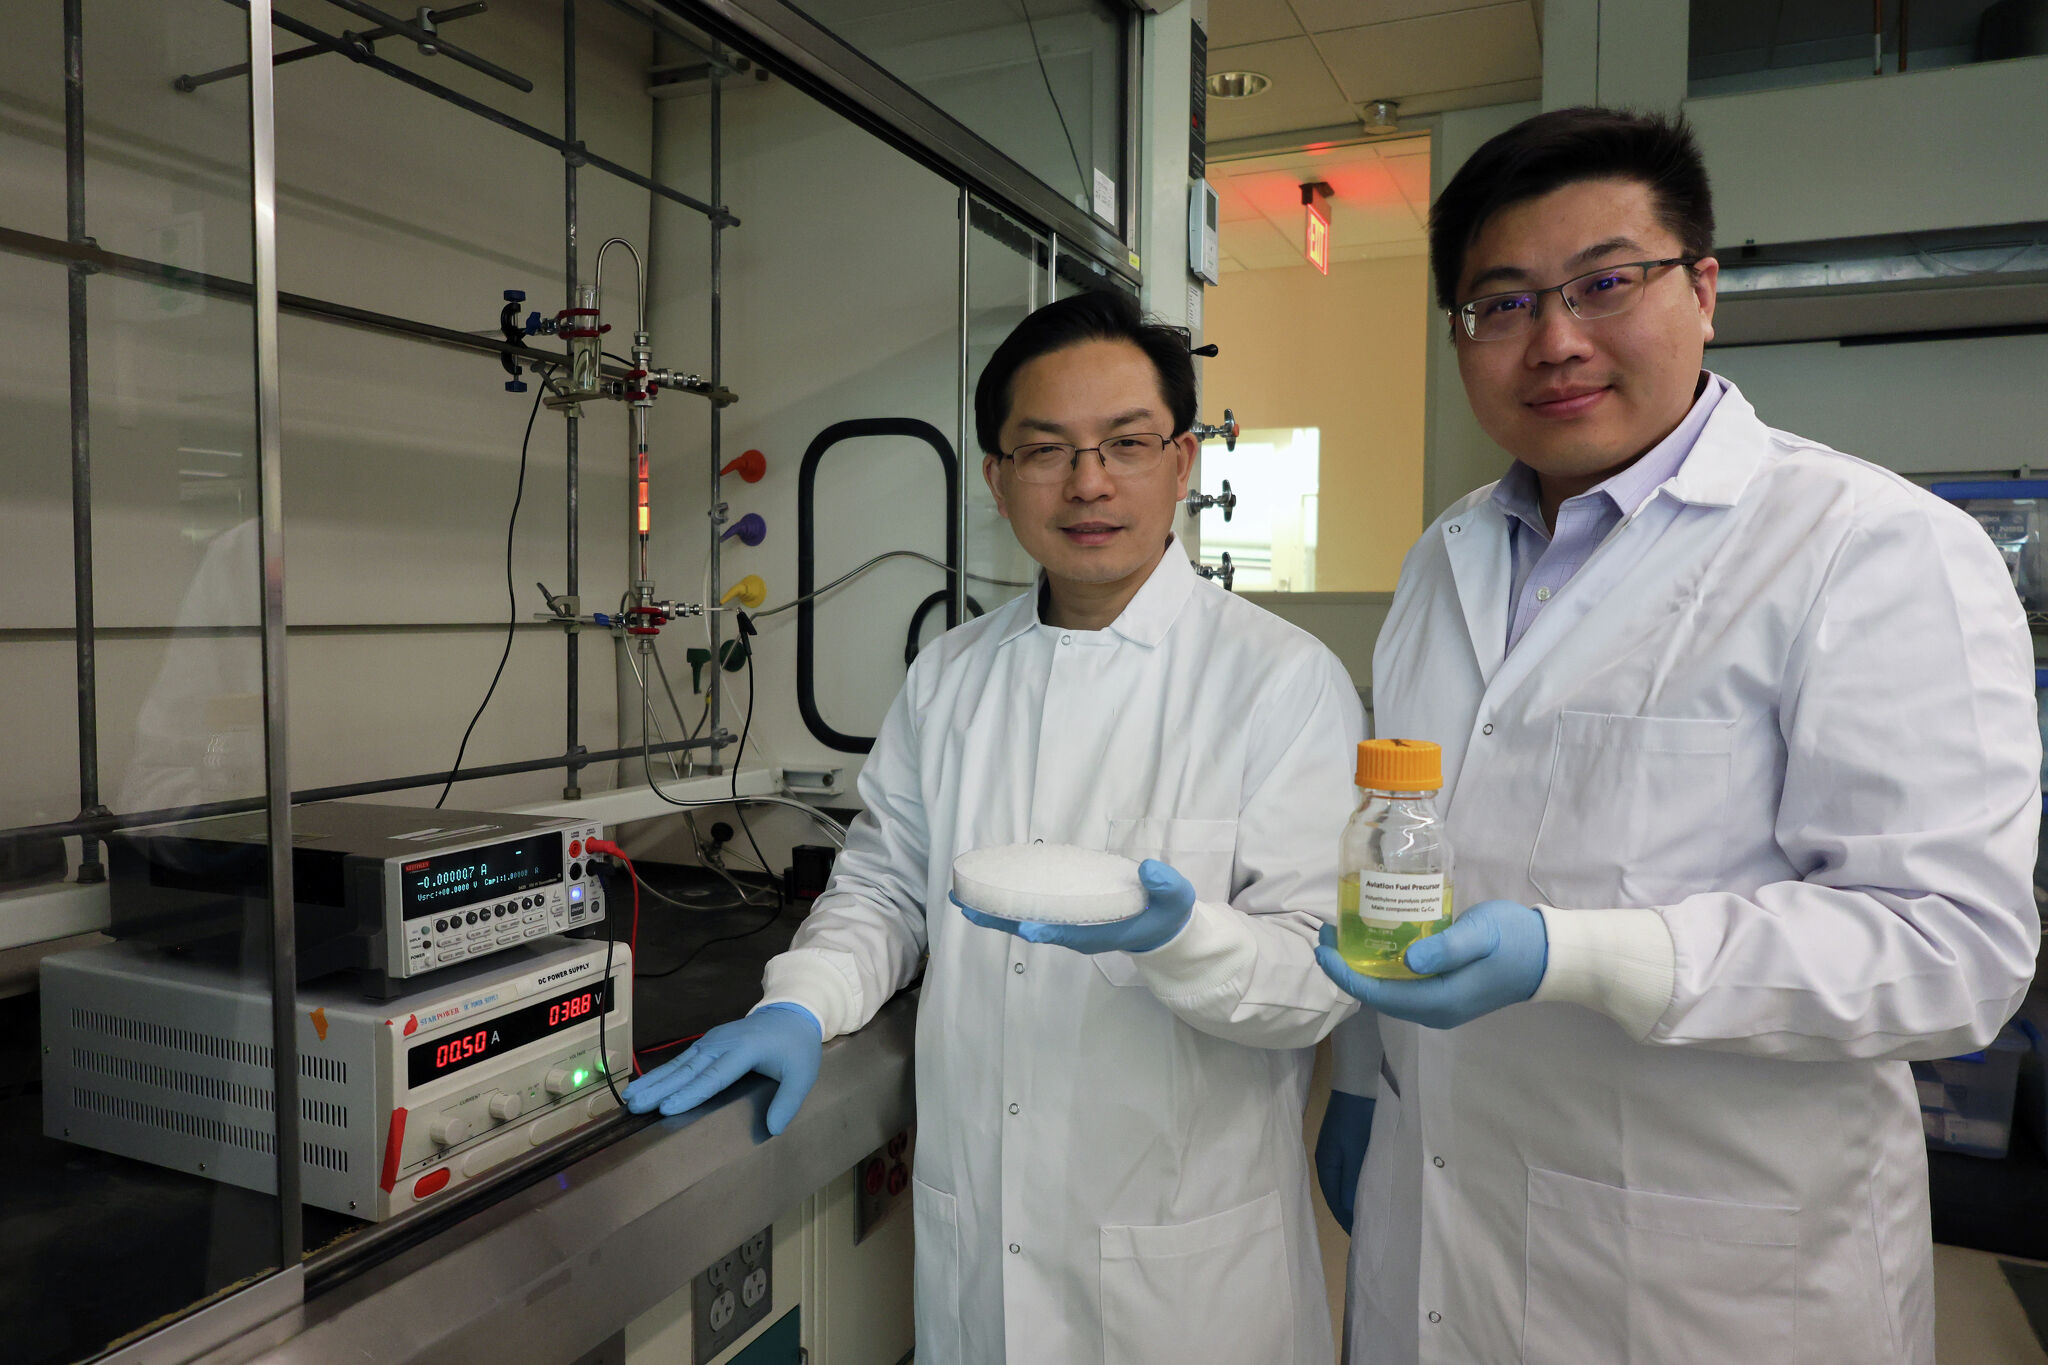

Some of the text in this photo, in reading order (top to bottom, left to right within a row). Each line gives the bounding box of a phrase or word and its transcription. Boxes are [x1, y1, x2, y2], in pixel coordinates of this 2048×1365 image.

[1309, 213, 1325, 269] EXIT
[417, 863, 487, 889] -0.000007 A
[473, 880, 478, 889] V
[1365, 880, 1440, 891] Aviation Fuel Precursor
[410, 952, 426, 960] POWER
[538, 962, 590, 985] DC POWER SUPPLY
[420, 1007, 460, 1026] STARPOWER
[490, 1030, 501, 1045] A
[594, 992, 602, 1005] V
[569, 1050, 586, 1060] VOLTAGE
[459, 1093, 481, 1106] CURRENT
